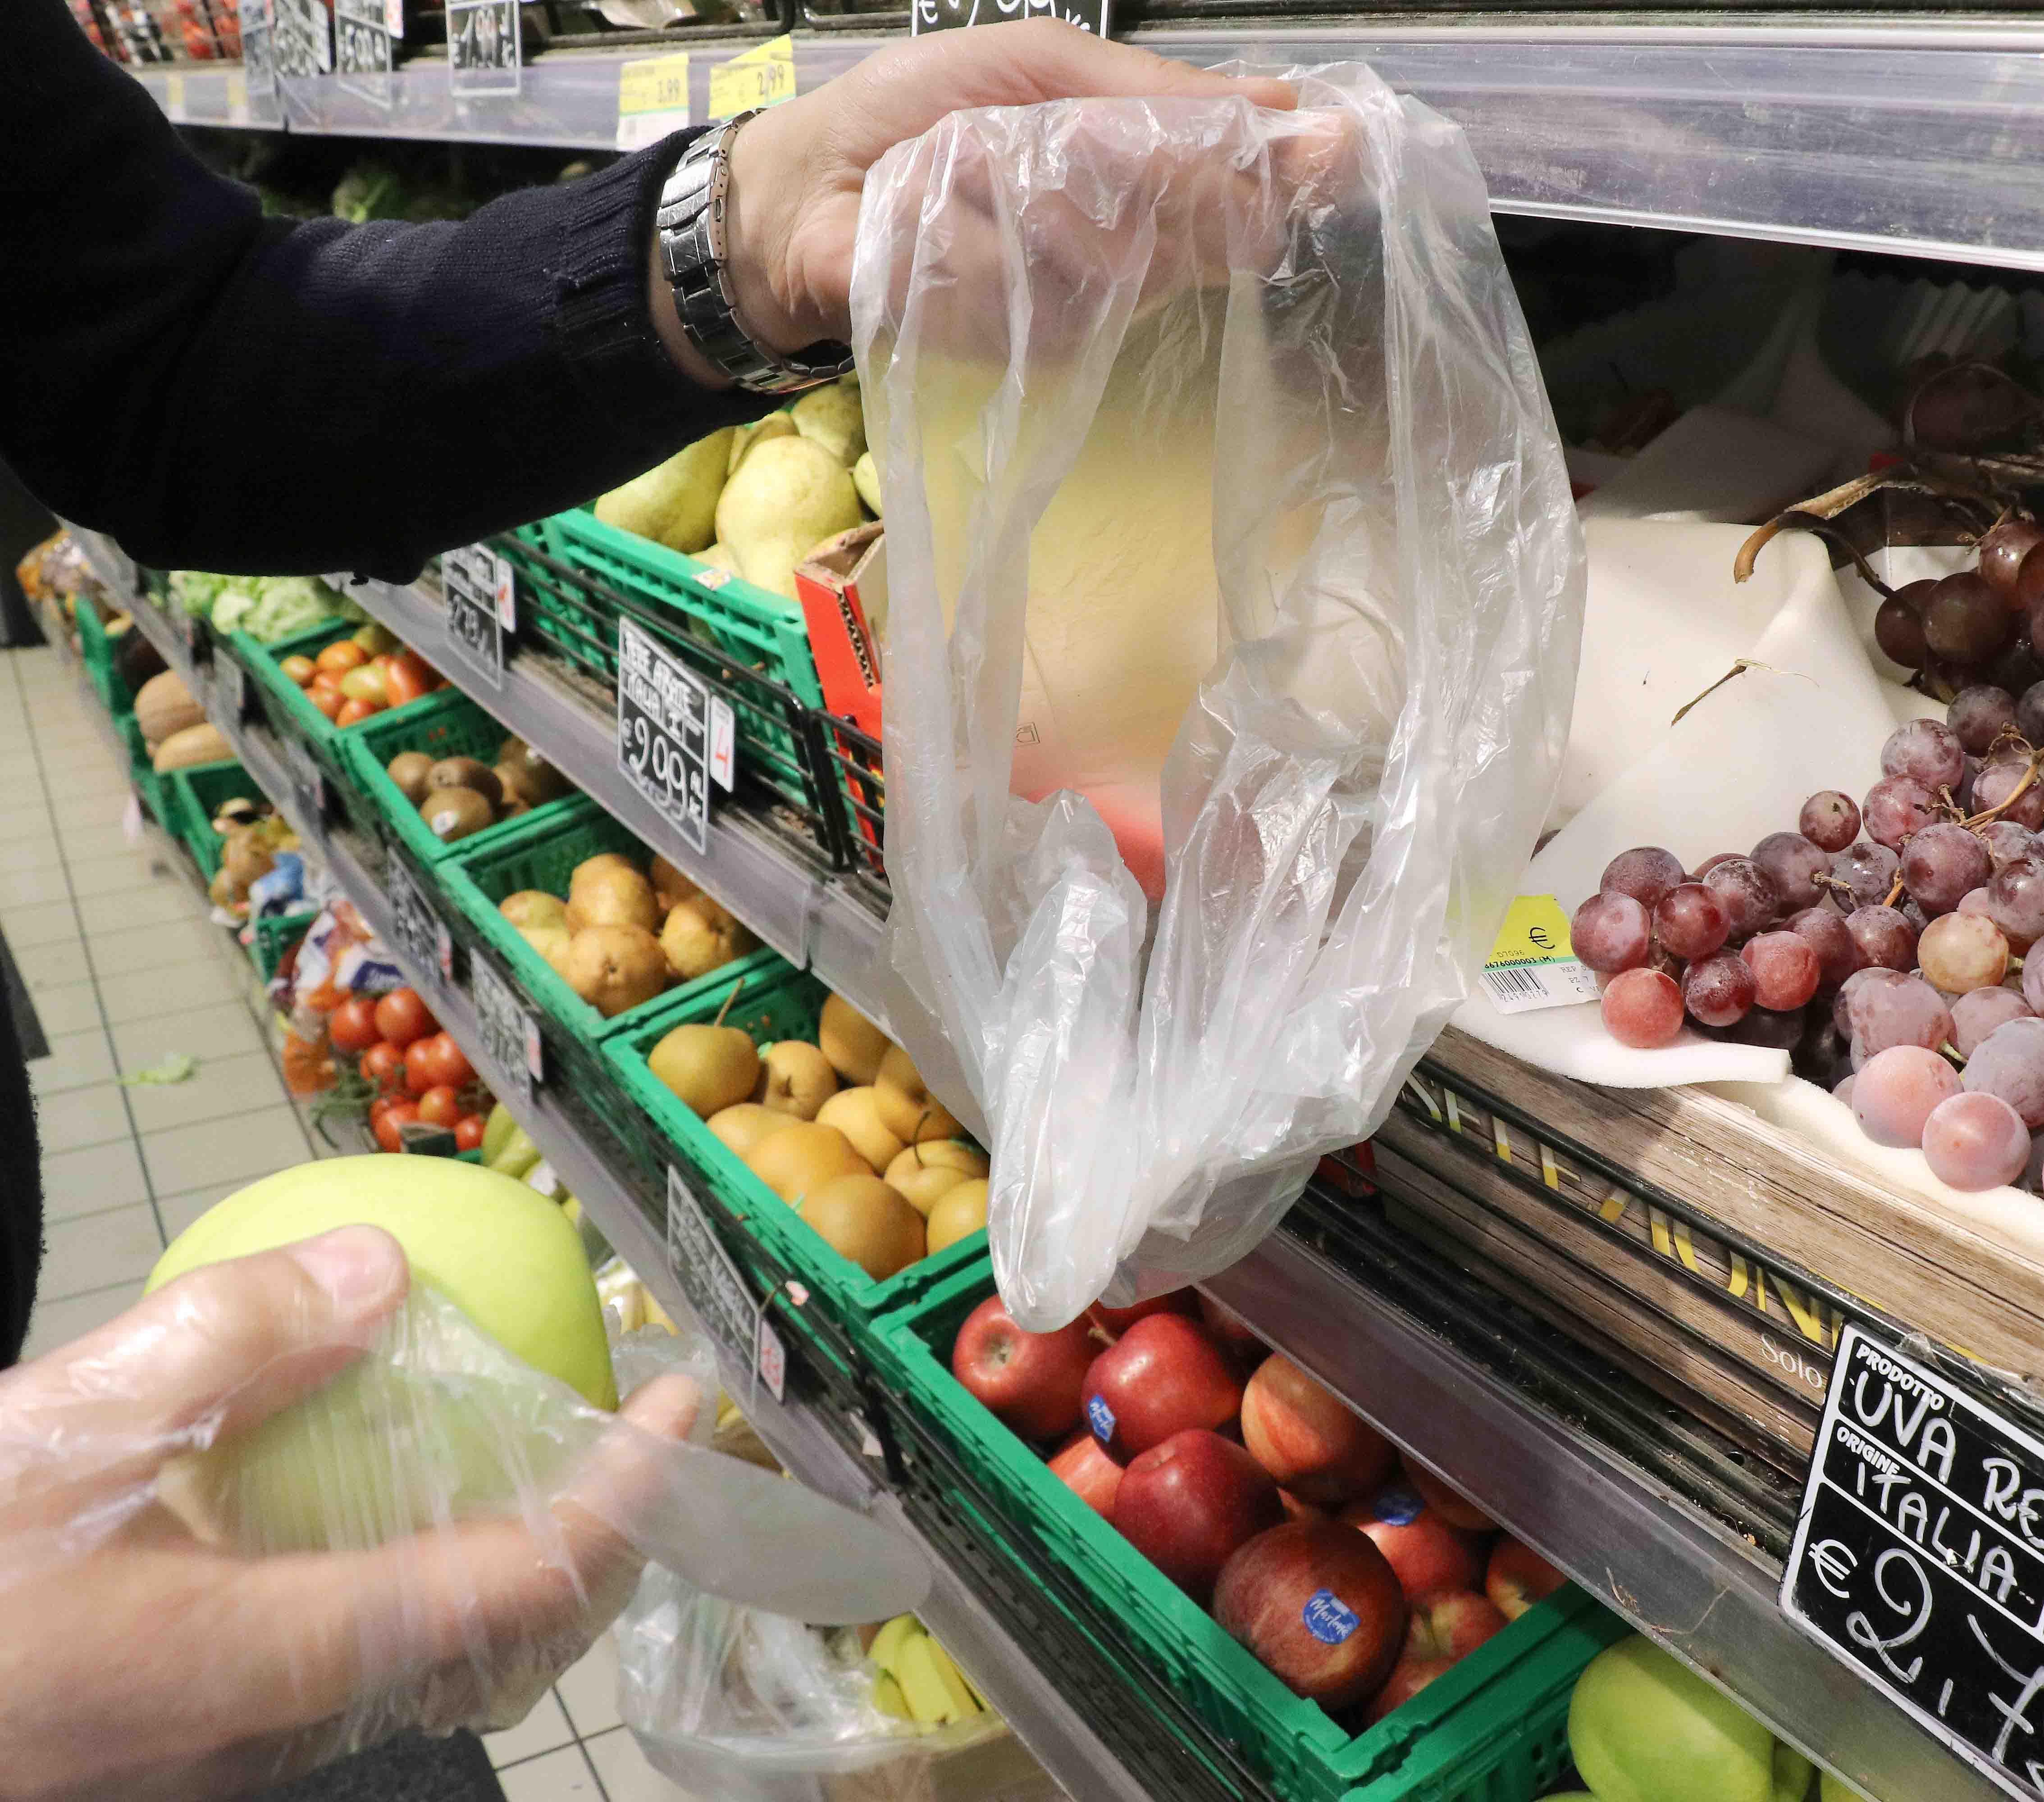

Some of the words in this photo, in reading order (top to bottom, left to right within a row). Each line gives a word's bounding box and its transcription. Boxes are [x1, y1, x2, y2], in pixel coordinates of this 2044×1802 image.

[1528, 927, 1555, 949] €
[1761, 1333, 1823, 1388] Solo
[1856, 1343, 1945, 1411] PRODOTTO
[1836, 1426, 1900, 1476] ORIGINE
[1854, 1370, 1957, 1485] UVA
[1808, 1539, 1858, 1599] €
